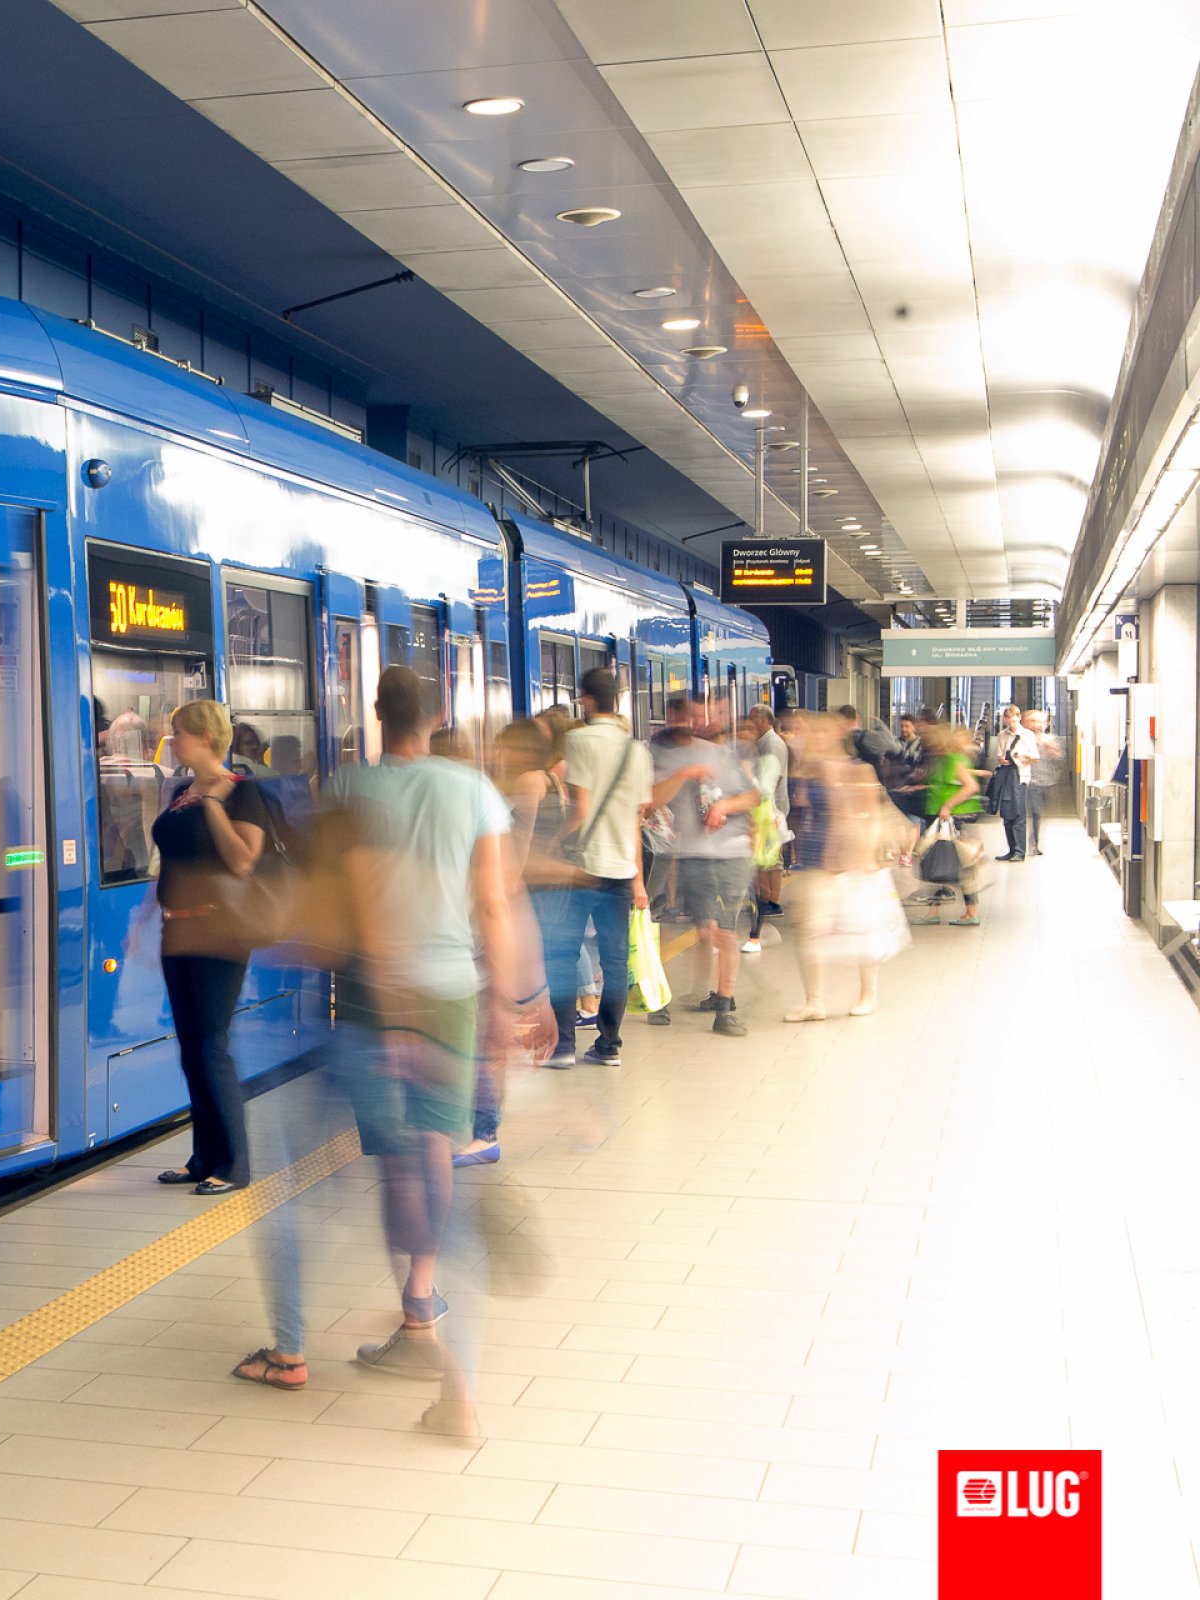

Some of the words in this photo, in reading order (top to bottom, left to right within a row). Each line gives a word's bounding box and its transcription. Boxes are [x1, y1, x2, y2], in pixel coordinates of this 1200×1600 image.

[733, 549, 768, 557] Dworzec
[769, 548, 800, 558] Główny
[109, 579, 127, 634] 50
[128, 584, 185, 632] Kurdwanów
